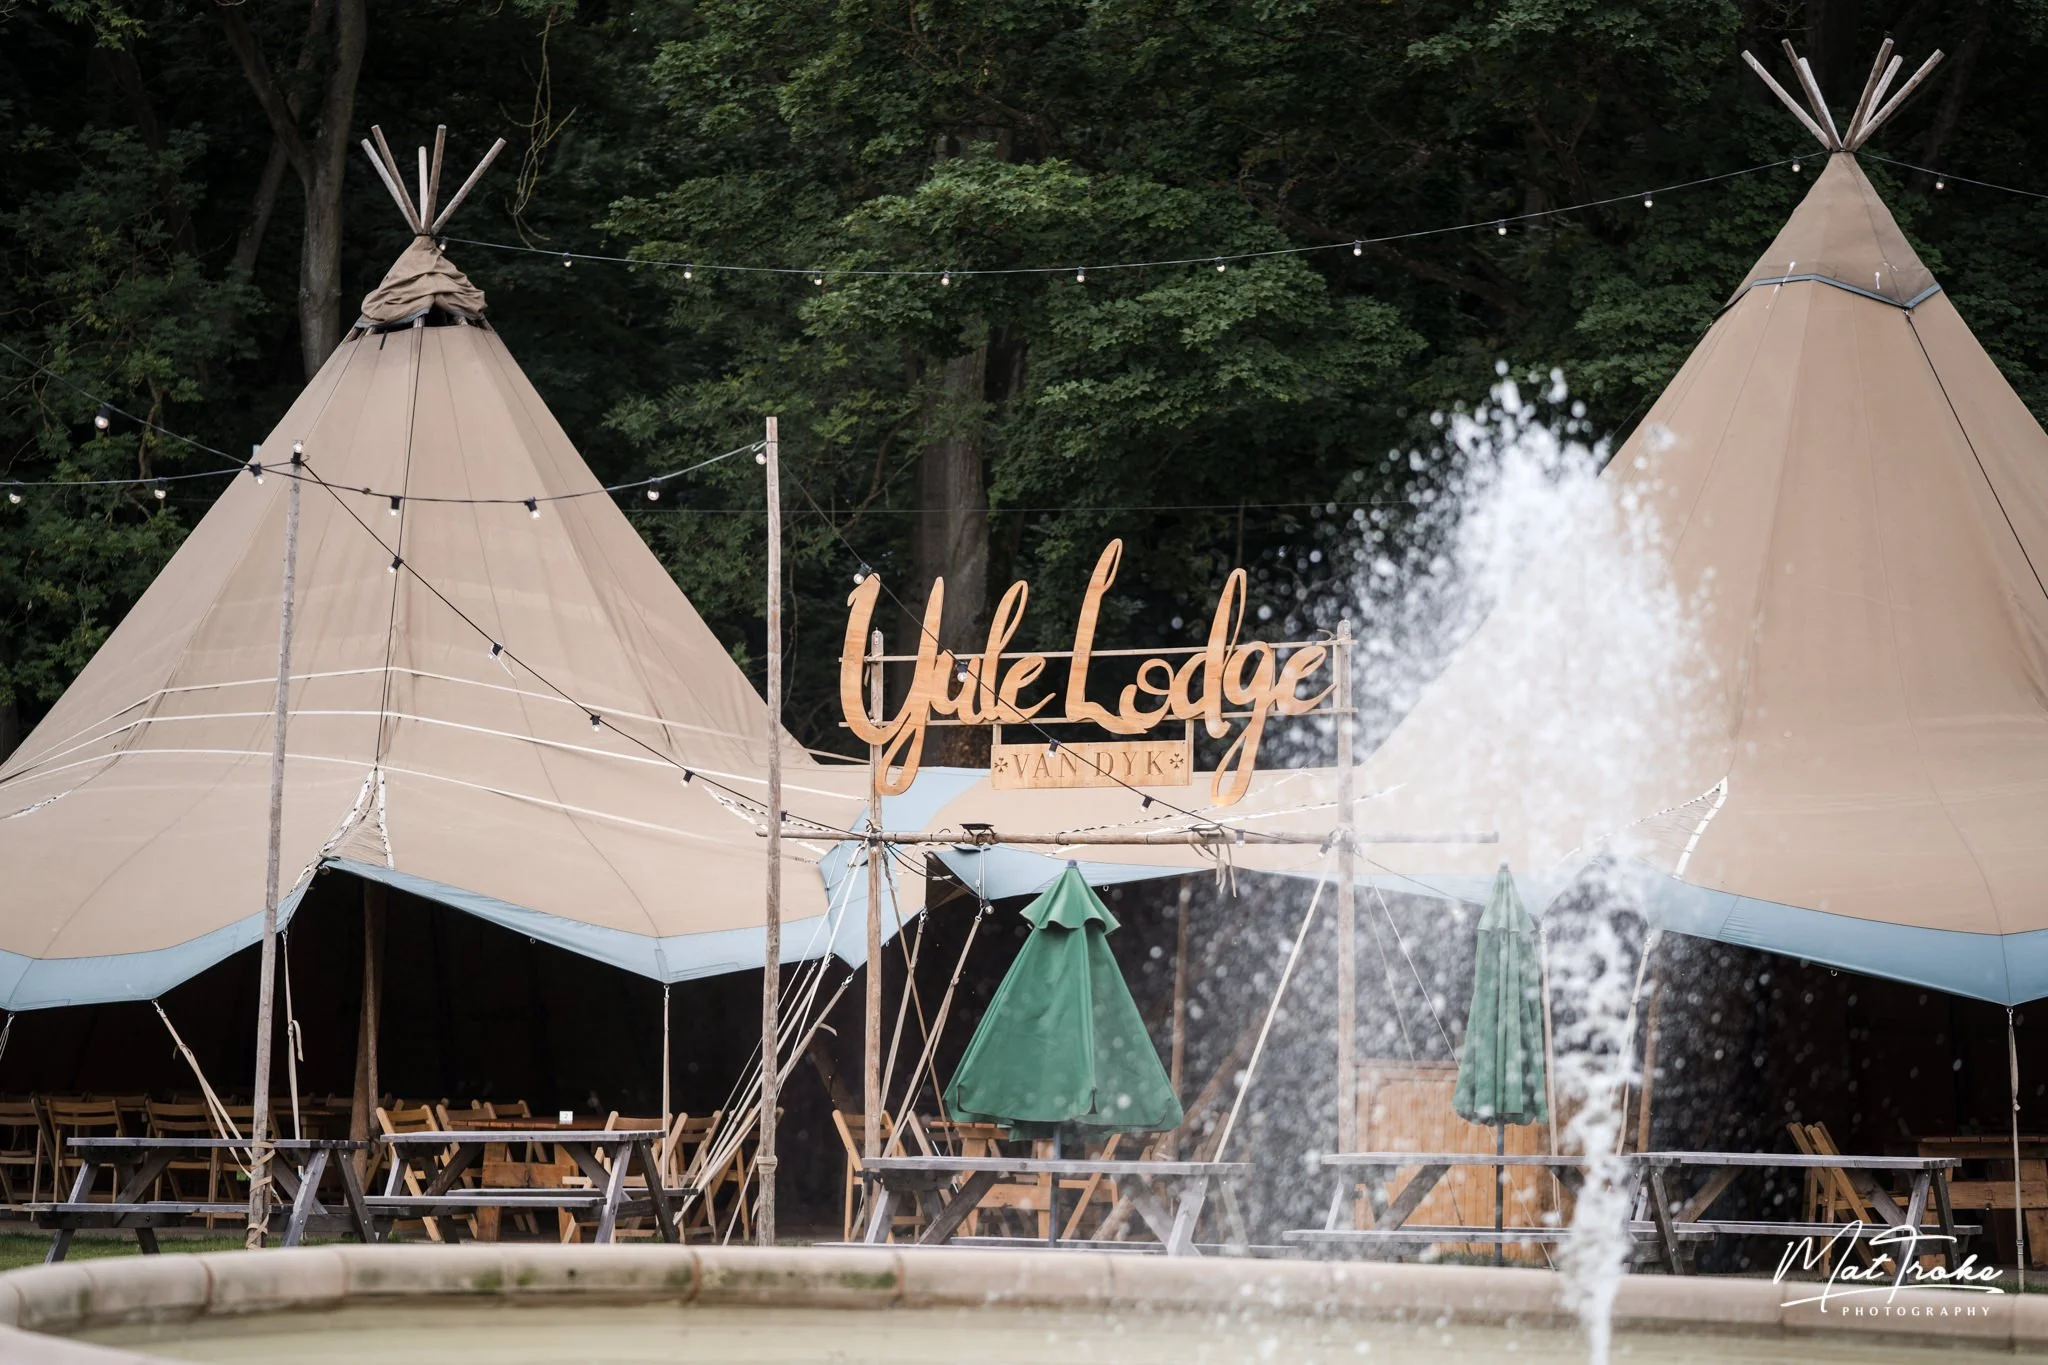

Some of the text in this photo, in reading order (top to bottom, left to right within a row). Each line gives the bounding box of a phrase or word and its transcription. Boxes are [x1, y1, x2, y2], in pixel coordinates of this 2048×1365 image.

[840, 538, 1337, 806] Yule Lodge
[1011, 750, 1166, 778] VAN DYK
